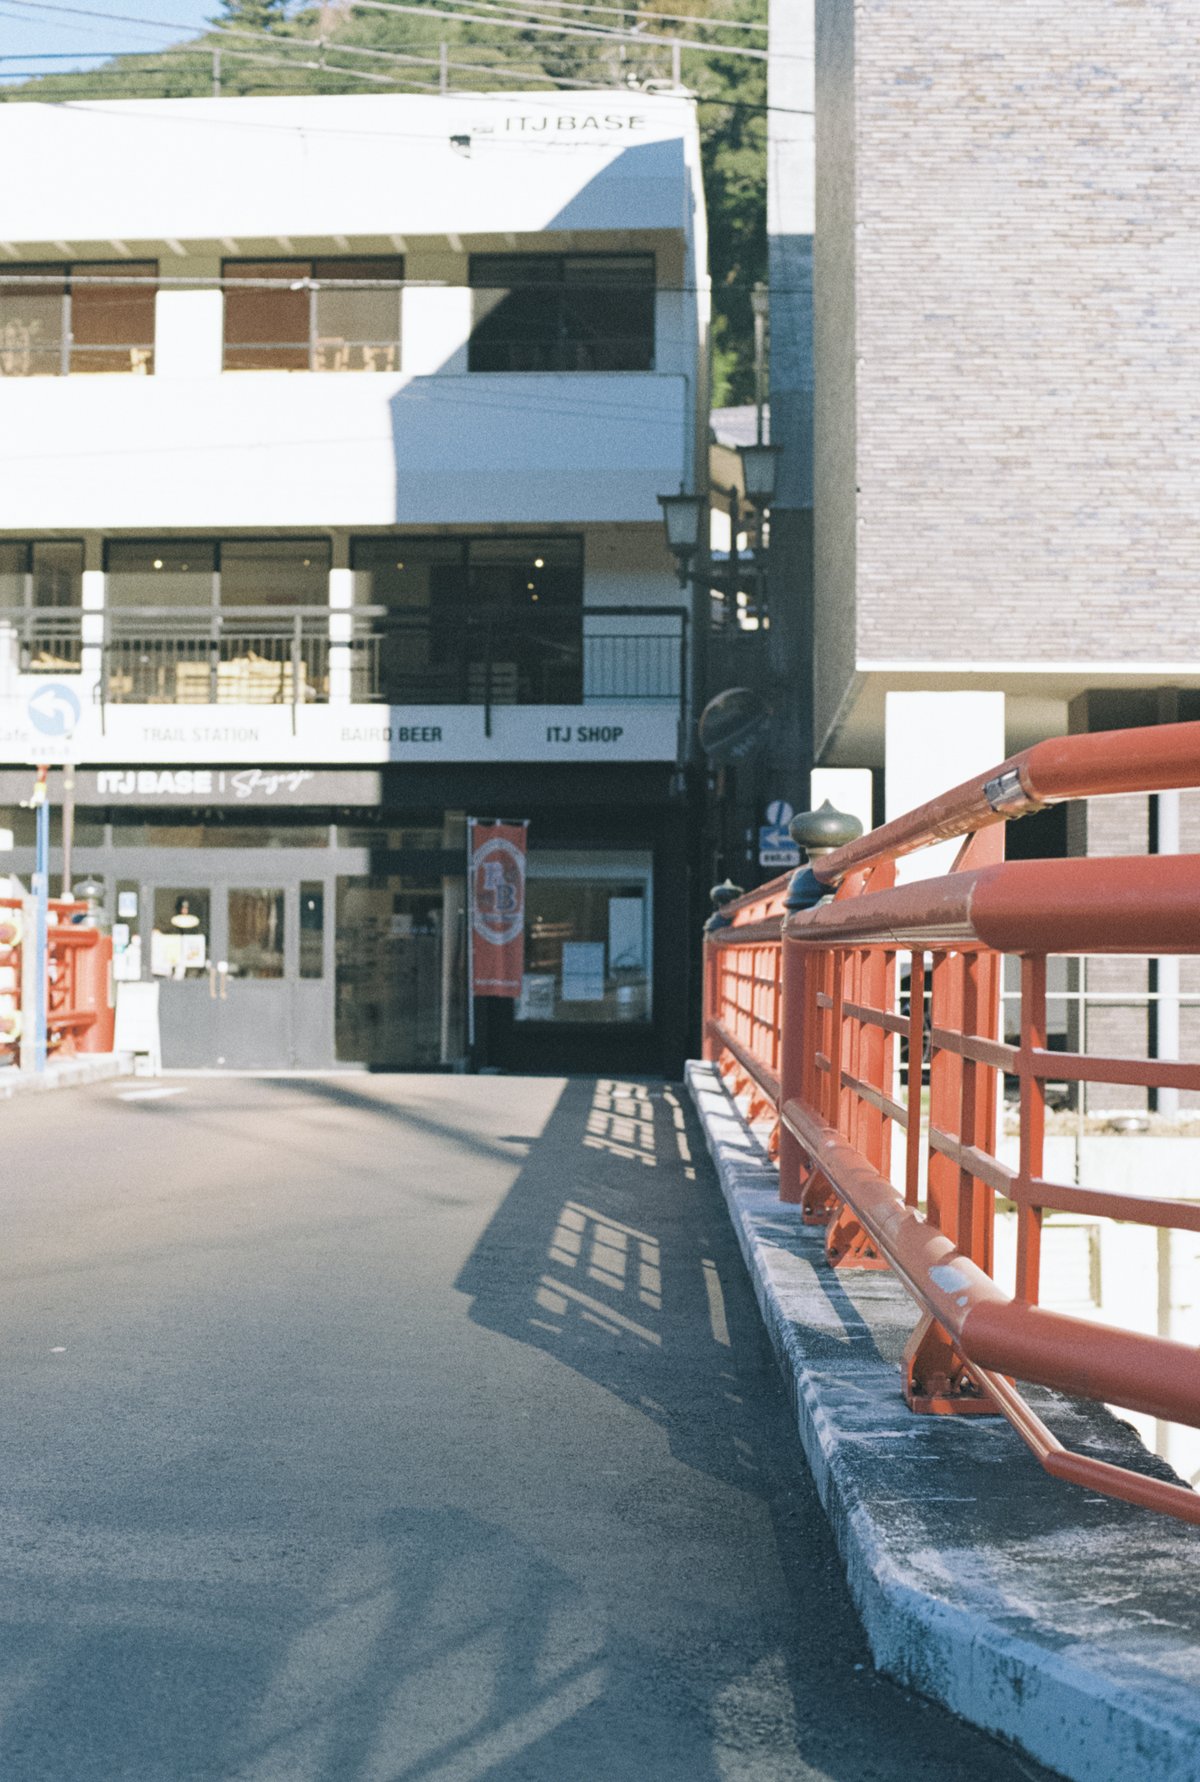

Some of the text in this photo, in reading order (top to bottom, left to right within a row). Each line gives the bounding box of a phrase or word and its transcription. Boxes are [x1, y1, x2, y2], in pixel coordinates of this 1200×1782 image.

[557, 115, 645, 131] BASE
[142, 727, 260, 742] TRAIL STATION
[340, 726, 442, 743] BAIRD BEER
[546, 726, 624, 743] ITJ SHOP
[137, 771, 212, 794] BASE
